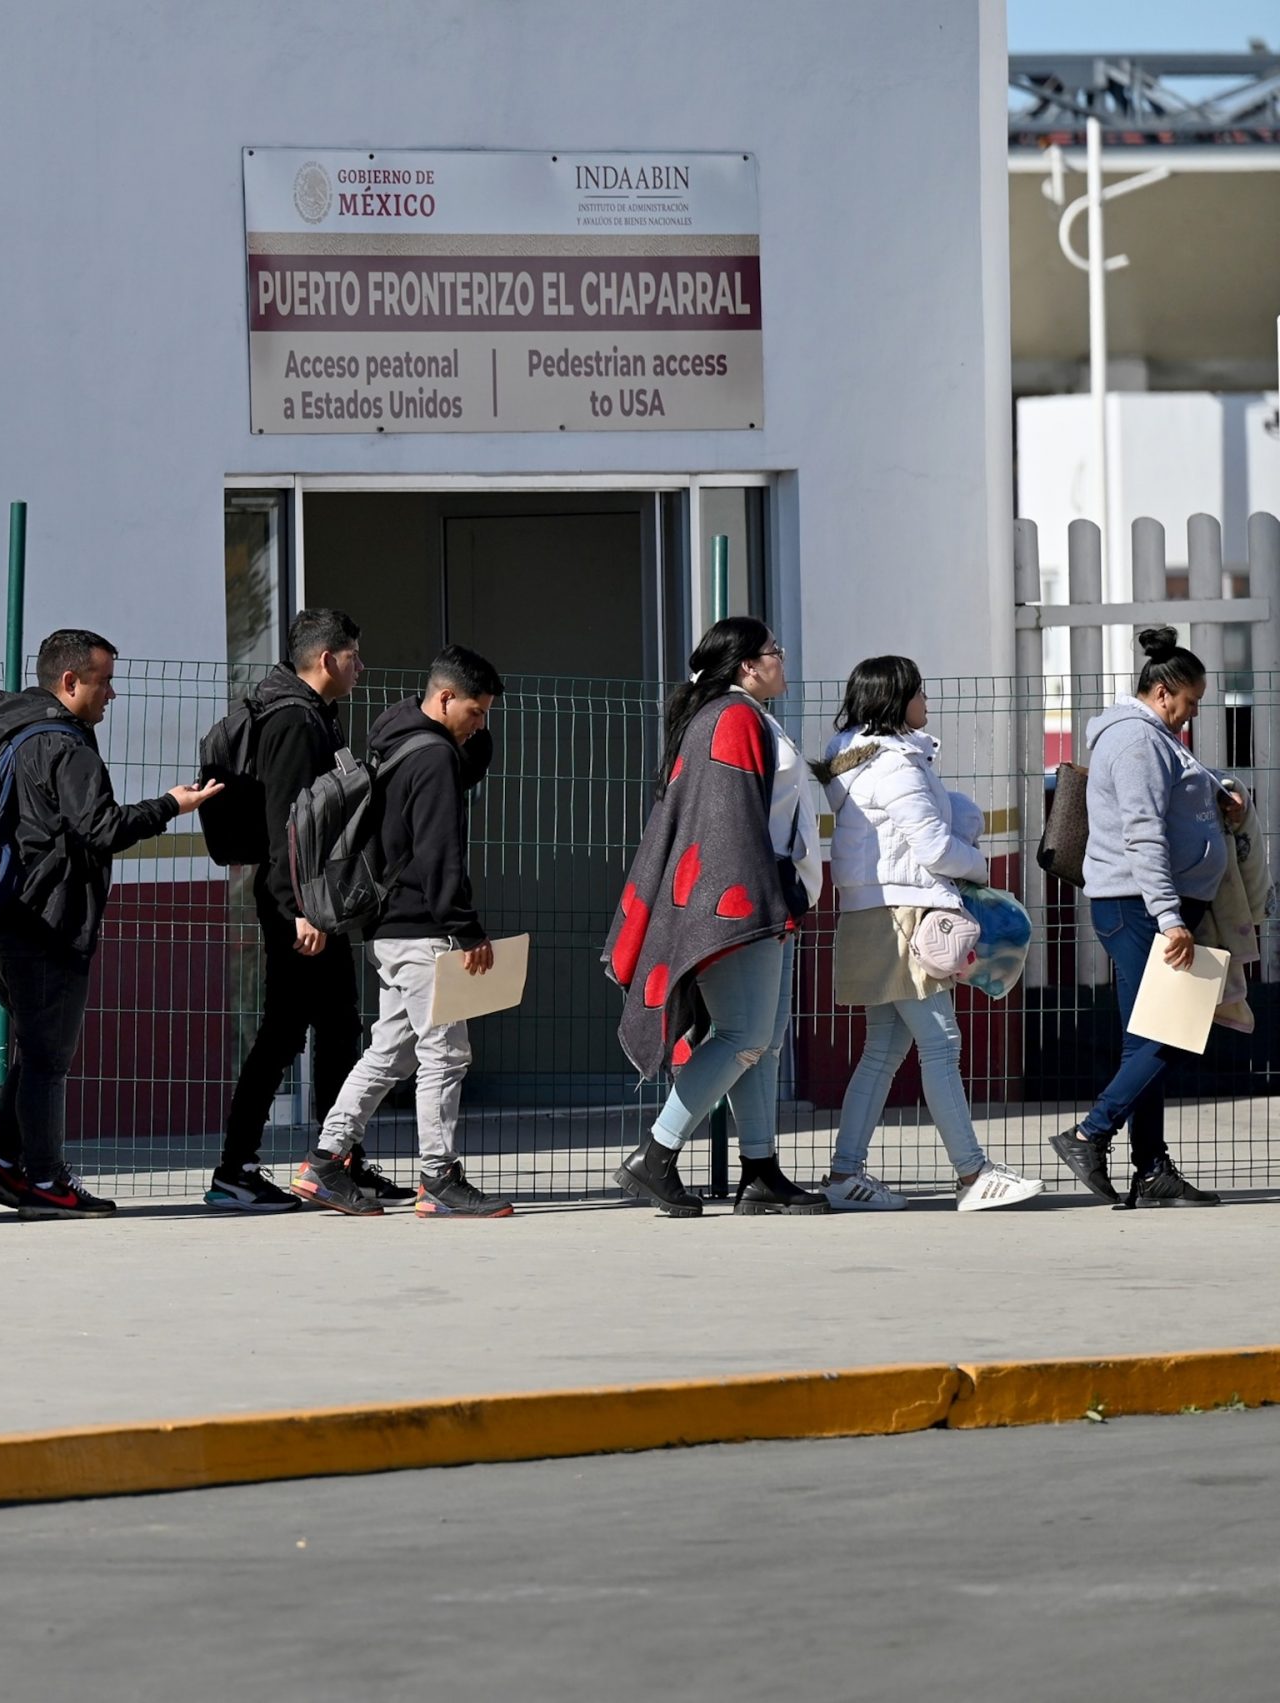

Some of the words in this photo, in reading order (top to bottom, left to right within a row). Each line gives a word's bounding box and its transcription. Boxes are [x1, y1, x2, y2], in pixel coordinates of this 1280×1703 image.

[337, 169, 411, 185] GOBIERNO
[416, 170, 434, 185] DE
[575, 165, 690, 190] INDAABIN
[338, 186, 436, 217] MÉXICO
[578, 203, 615, 212] INSTITUTO
[617, 203, 626, 212] DE
[628, 201, 689, 212] ADMINISTRACIÓN
[576, 217, 581, 226] Y
[582, 216, 613, 226] AVALÚOS
[613, 217, 622, 226] DE
[623, 217, 647, 226] BIENES
[648, 216, 693, 226] NACIONALES
[258, 270, 361, 317] PUERTO
[368, 270, 535, 317] FRONTERIZO
[542, 271, 574, 316] EL
[580, 271, 751, 317] CHAPARRAL
[284, 350, 360, 379] Acceso
[366, 348, 459, 386] peatonal
[528, 345, 646, 378] Pedestrian
[652, 353, 728, 377] access
[283, 396, 295, 420] a
[301, 389, 384, 420] Estados
[389, 387, 463, 419] Unidos
[589, 390, 613, 417] to
[619, 388, 665, 417] USA
